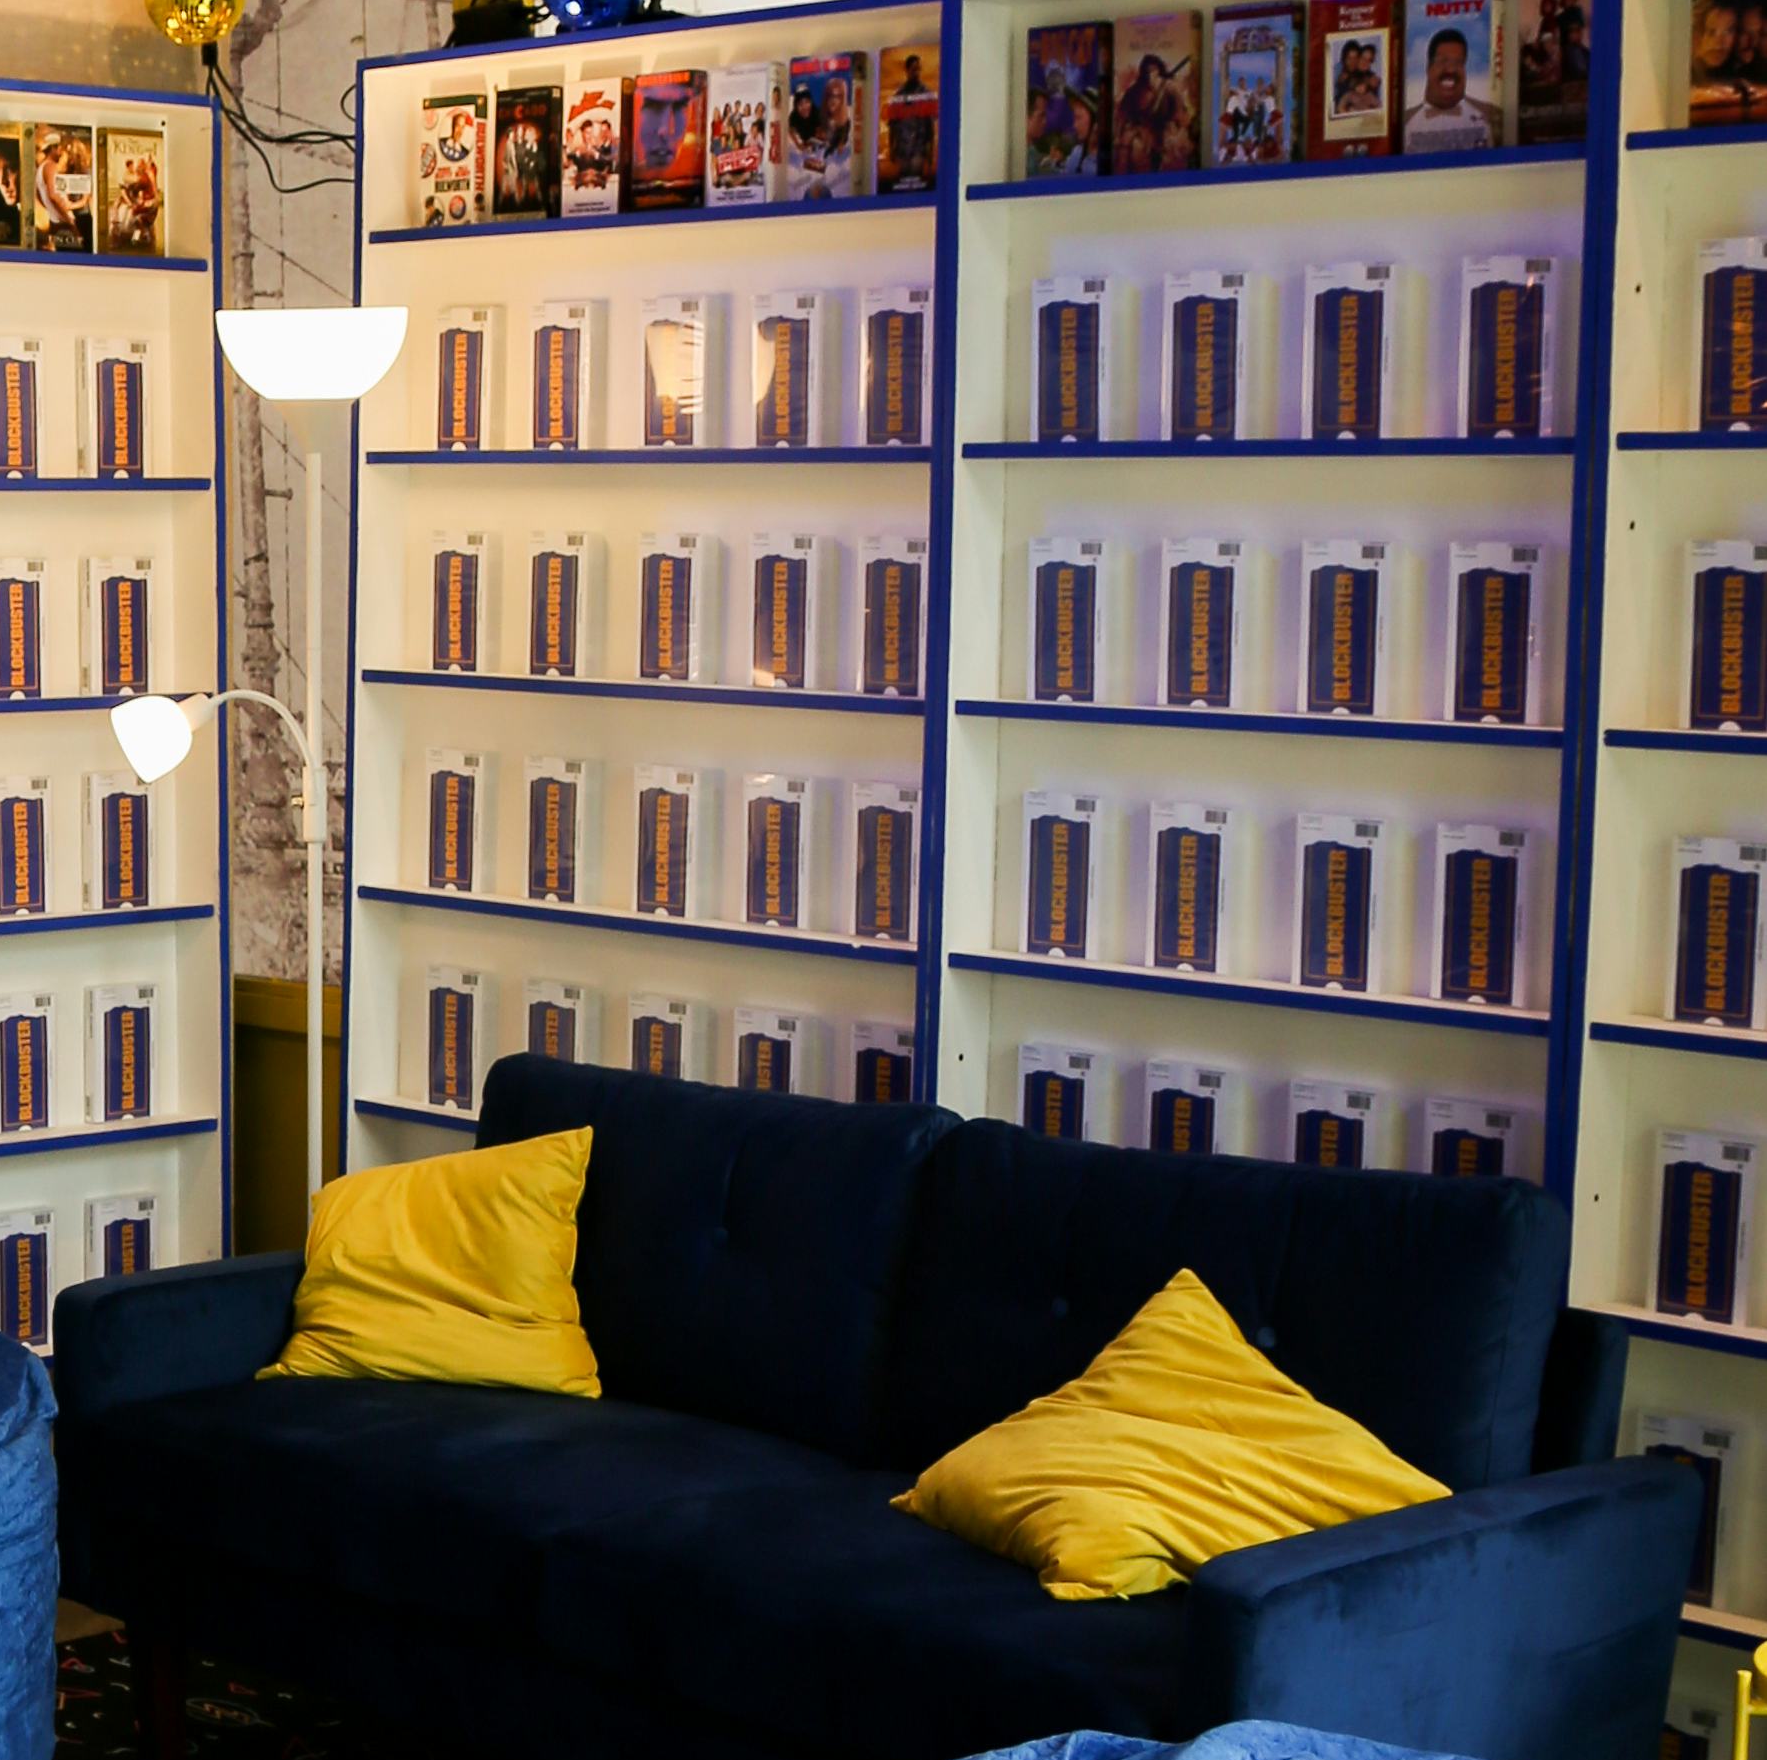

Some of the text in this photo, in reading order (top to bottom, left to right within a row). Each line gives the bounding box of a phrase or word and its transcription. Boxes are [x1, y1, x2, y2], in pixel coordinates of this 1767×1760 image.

[1425, 0, 1484, 17] NUTTY
[453, 333, 467, 442] BLOCKBUSTER
[549, 331, 563, 442] BLOCKBUSTER
[1060, 308, 1077, 430] BLOCKBUSTER
[1196, 303, 1213, 430] BLOCKBUSTER
[1339, 296, 1358, 425] BLOCKBUSTER
[1496, 290, 1516, 424] BLOCKBUSTER
[1731, 276, 1754, 415] BLOCKBUSTER
[6, 363, 22, 468] BLOCKBUSTER
[114, 364, 128, 468] BLOCKBUSTER
[10, 584, 24, 690] BLOCKBUSTER
[118, 582, 133, 686] BLOCKBUSTER
[449, 557, 461, 663] BLOCKBUSTER
[547, 558, 561, 665] BLOCKBUSTER
[659, 560, 672, 671] BLOCKBUSTER
[773, 562, 787, 677] BLOCKBUSTER
[884, 567, 900, 685] BLOCKBUSTER
[1057, 570, 1073, 690] BLOCKBUSTER
[1191, 571, 1209, 696] BLOCKBUSTER
[1333, 574, 1352, 701] BLOCKBUSTER
[1482, 579, 1502, 708] BLOCKBUSTER
[1721, 577, 1743, 716] BLOCKBUSTER
[14, 802, 29, 907] BLOCKBUSTER
[119, 798, 133, 901] BLOCKBUSTER
[446, 777, 458, 882] BLOCKBUSTER
[546, 784, 559, 891] BLOCKBUSTER
[656, 795, 670, 905] BLOCKBUSTER
[765, 804, 780, 917] BLOCKBUSTER
[876, 814, 892, 927] BLOCKBUSTER
[1050, 824, 1068, 946] BLOCKBUSTER
[1178, 836, 1196, 960] BLOCKBUSTER
[1326, 851, 1346, 977] BLOCKBUSTER
[1469, 860, 1490, 991] BLOCKBUSTER
[1705, 875, 1729, 1014] BLOCKBUSTER
[18, 1021, 32, 1125] BLOCKBUSTER
[122, 1012, 134, 1112] BLOCKBUSTER
[445, 994, 457, 1099] BLOCKBUSTER
[1686, 1173, 1712, 1312] BLOCKBUSTER
